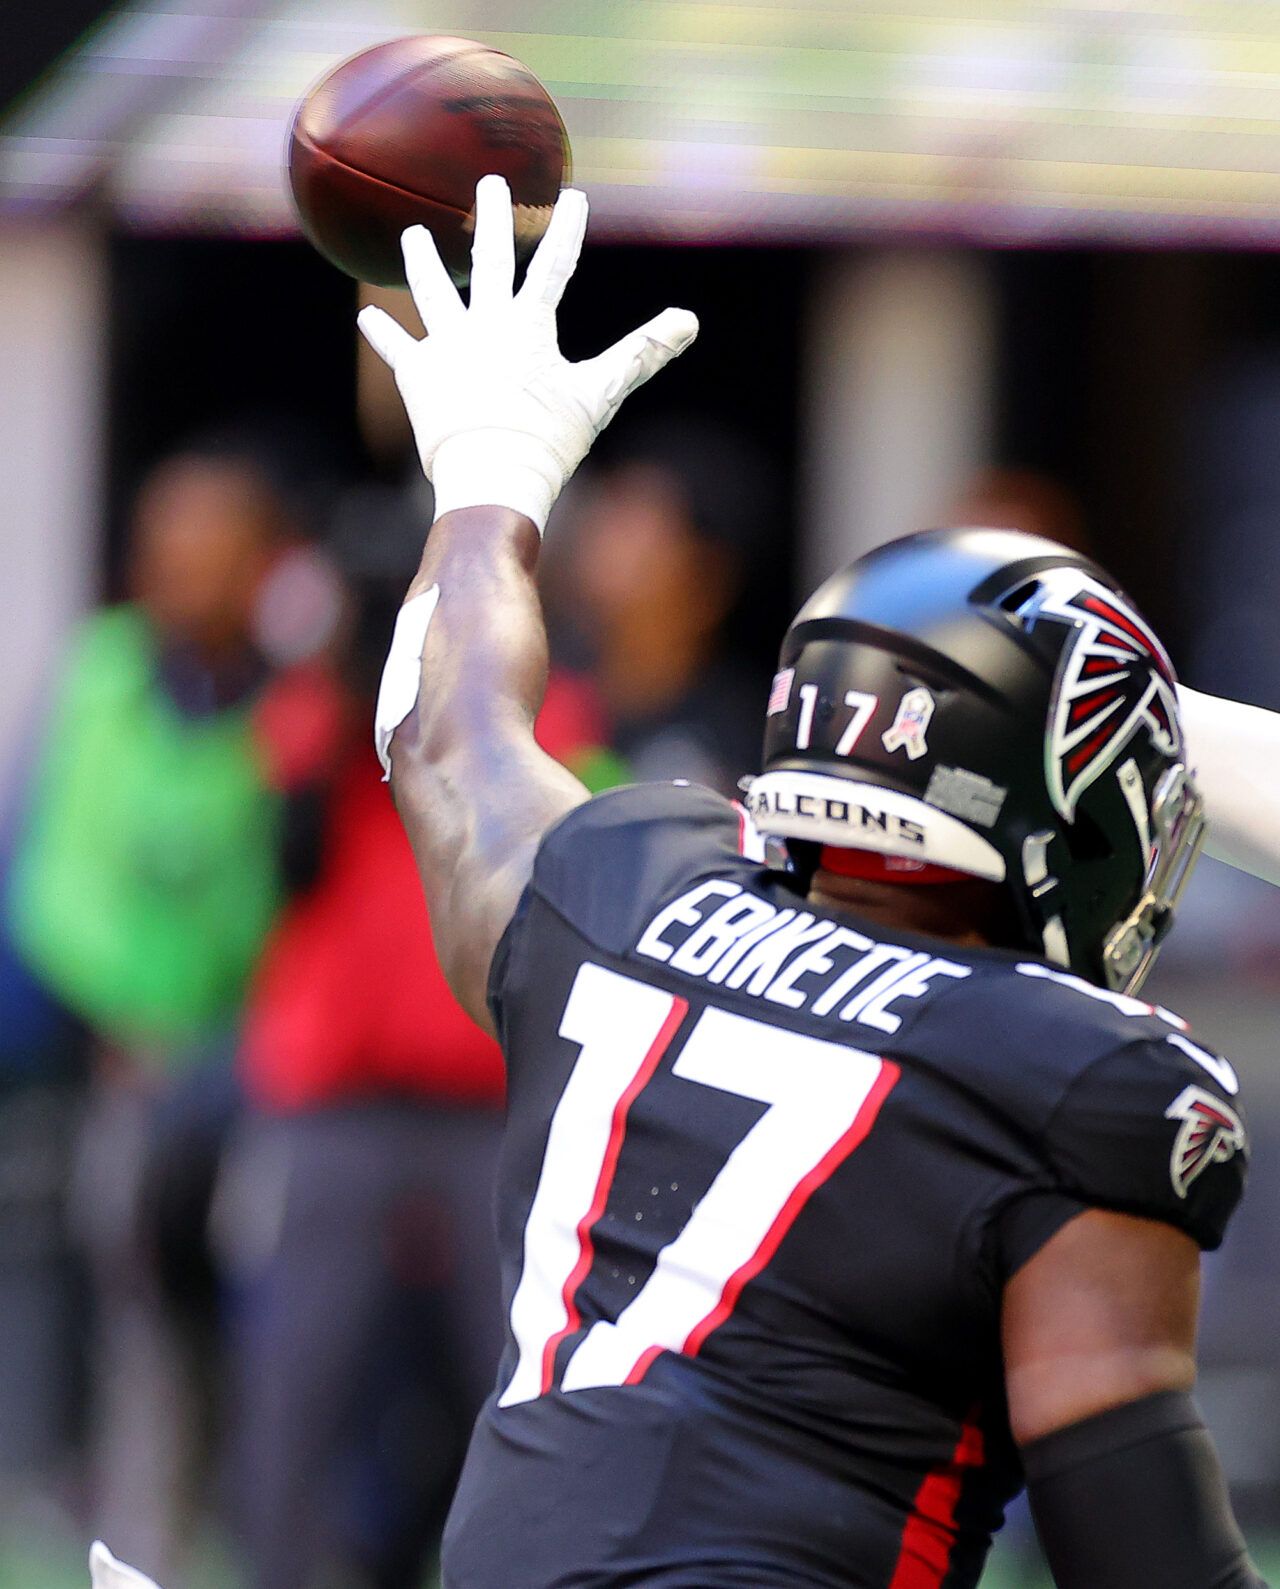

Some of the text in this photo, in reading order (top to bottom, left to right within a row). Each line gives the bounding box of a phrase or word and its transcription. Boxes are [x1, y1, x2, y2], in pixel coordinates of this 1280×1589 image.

[796, 684, 880, 756] 17
[745, 792, 925, 844] ALCONS
[636, 879, 972, 1034] EBIKETIE
[499, 961, 900, 1408] 17
